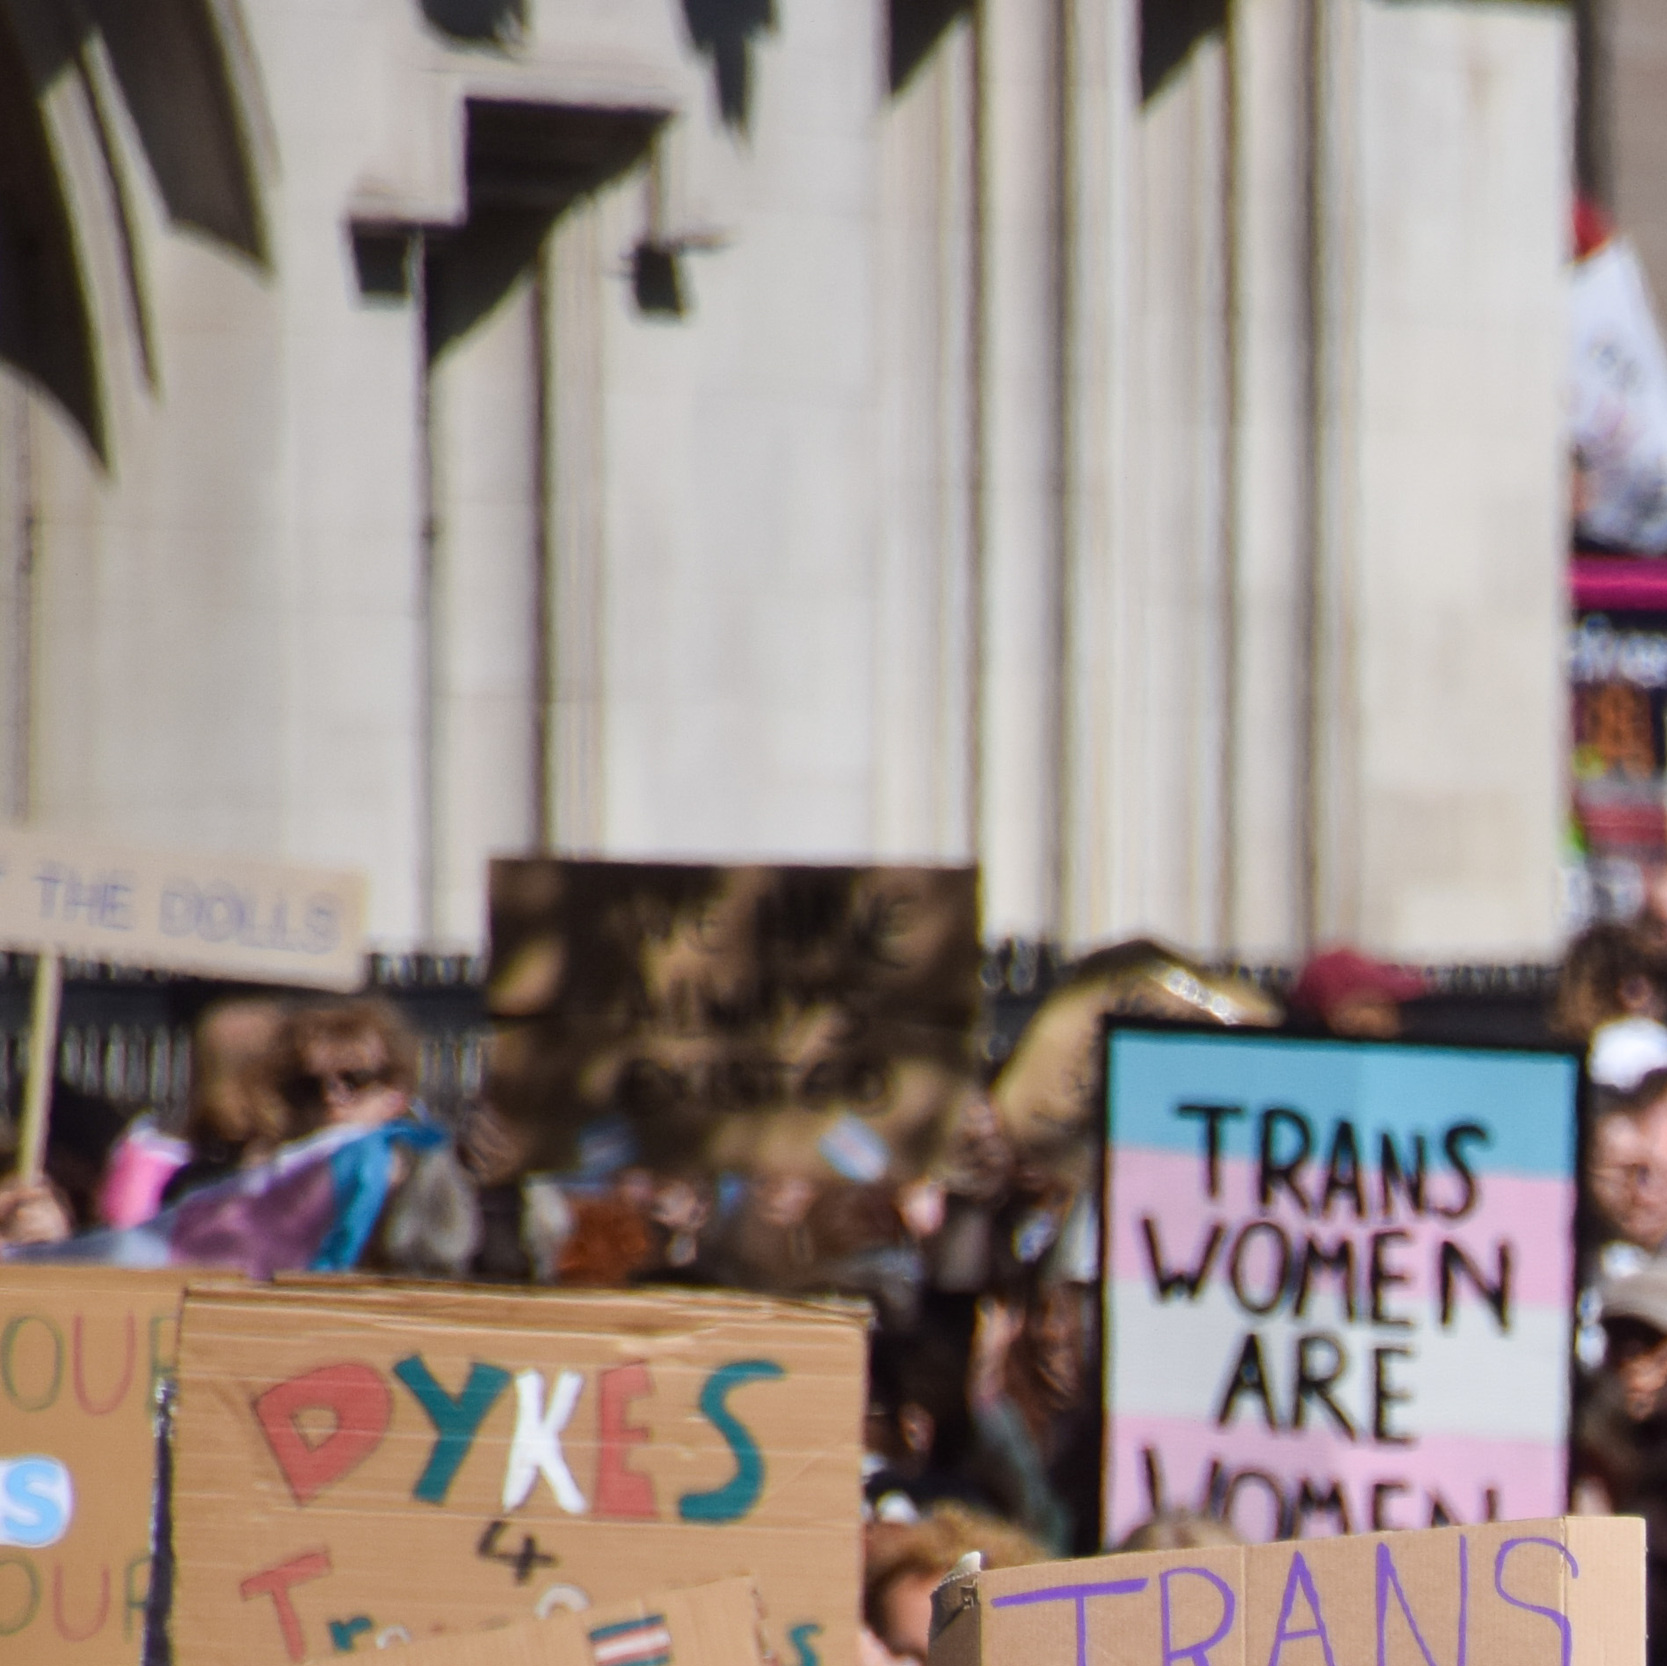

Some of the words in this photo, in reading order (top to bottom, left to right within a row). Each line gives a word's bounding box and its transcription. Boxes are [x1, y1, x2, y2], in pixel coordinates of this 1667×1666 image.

[34, 864, 135, 931] THE
[158, 880, 342, 955] DOLLS
[1177, 1104, 1493, 1221] TRANS
[1142, 1215, 1514, 1336] WOMEN
[252, 1355, 784, 1523] DYKES
[1217, 1332, 1420, 1445] ARE
[476, 1520, 559, 1586] 4
